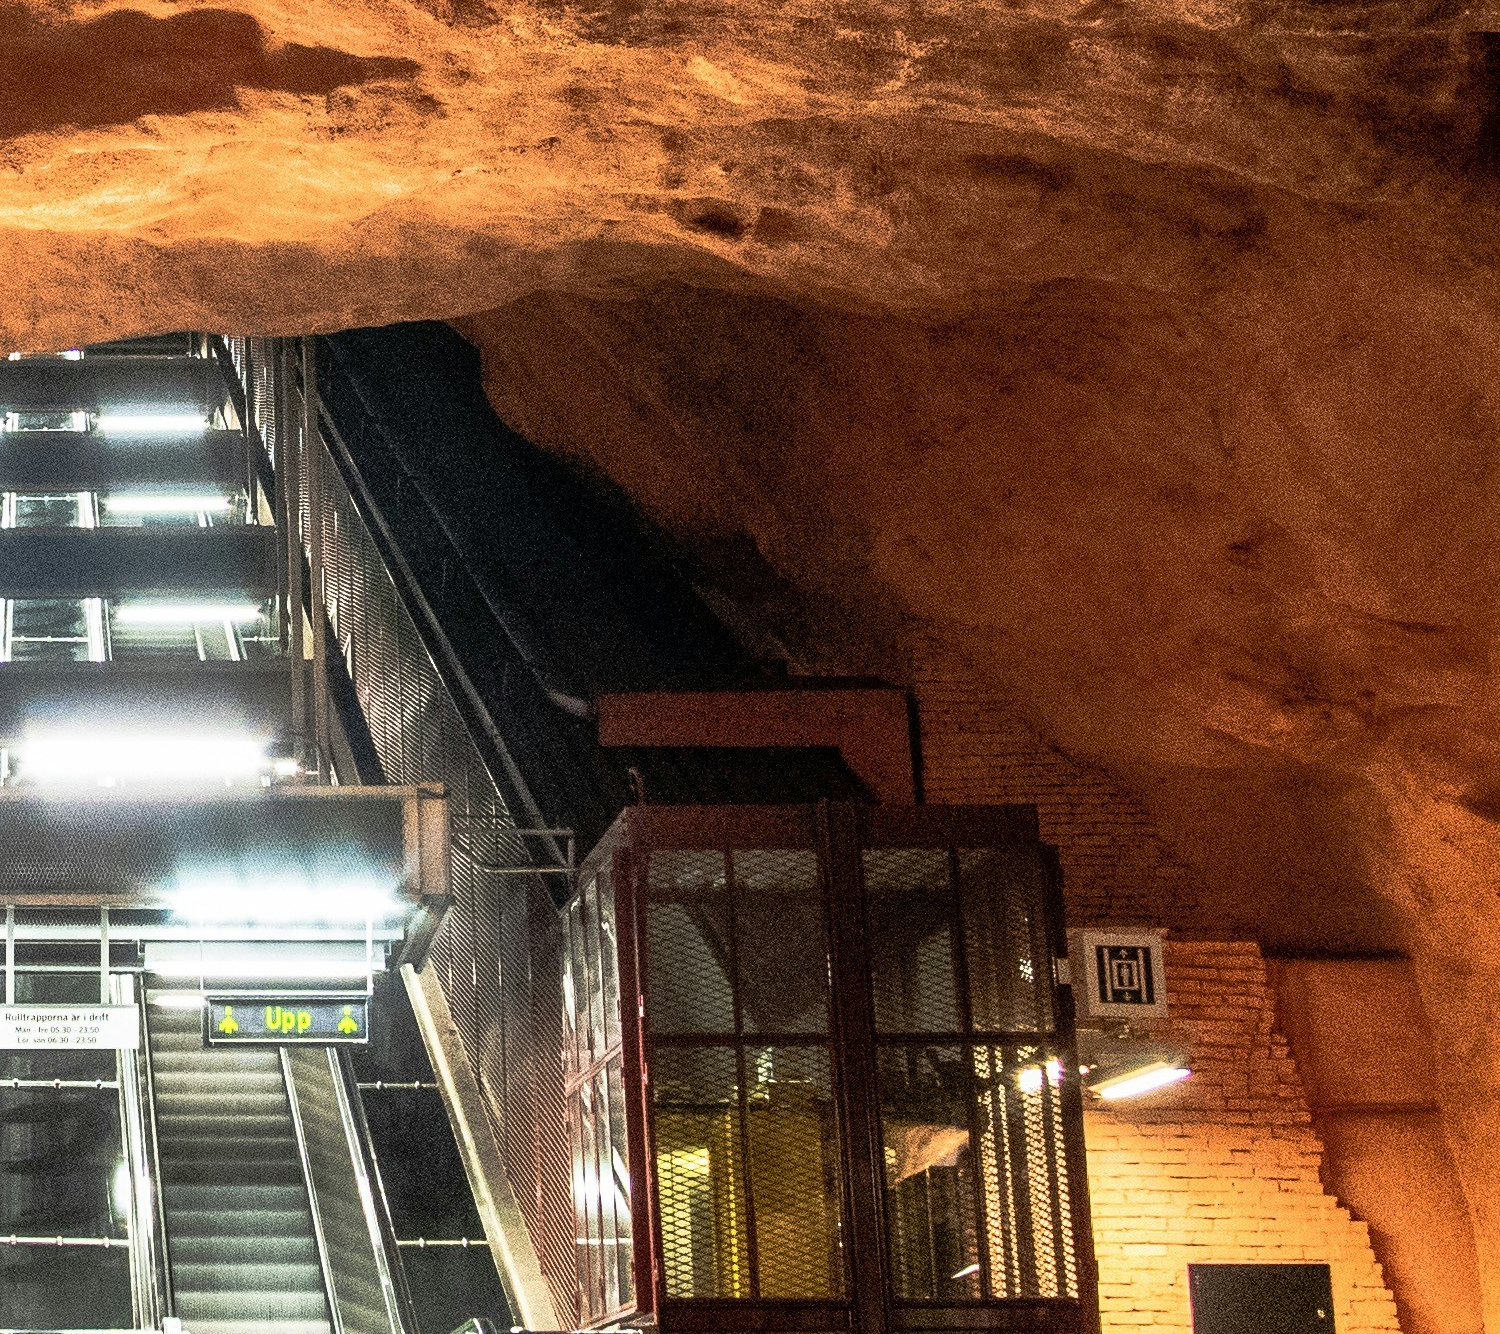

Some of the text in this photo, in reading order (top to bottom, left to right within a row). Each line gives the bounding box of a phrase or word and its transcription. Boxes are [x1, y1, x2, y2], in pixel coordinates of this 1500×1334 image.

[5, 1013, 68, 1023] Rulltrapporna
[89, 1012, 109, 1021] drift
[265, 1006, 312, 1033] Upp
